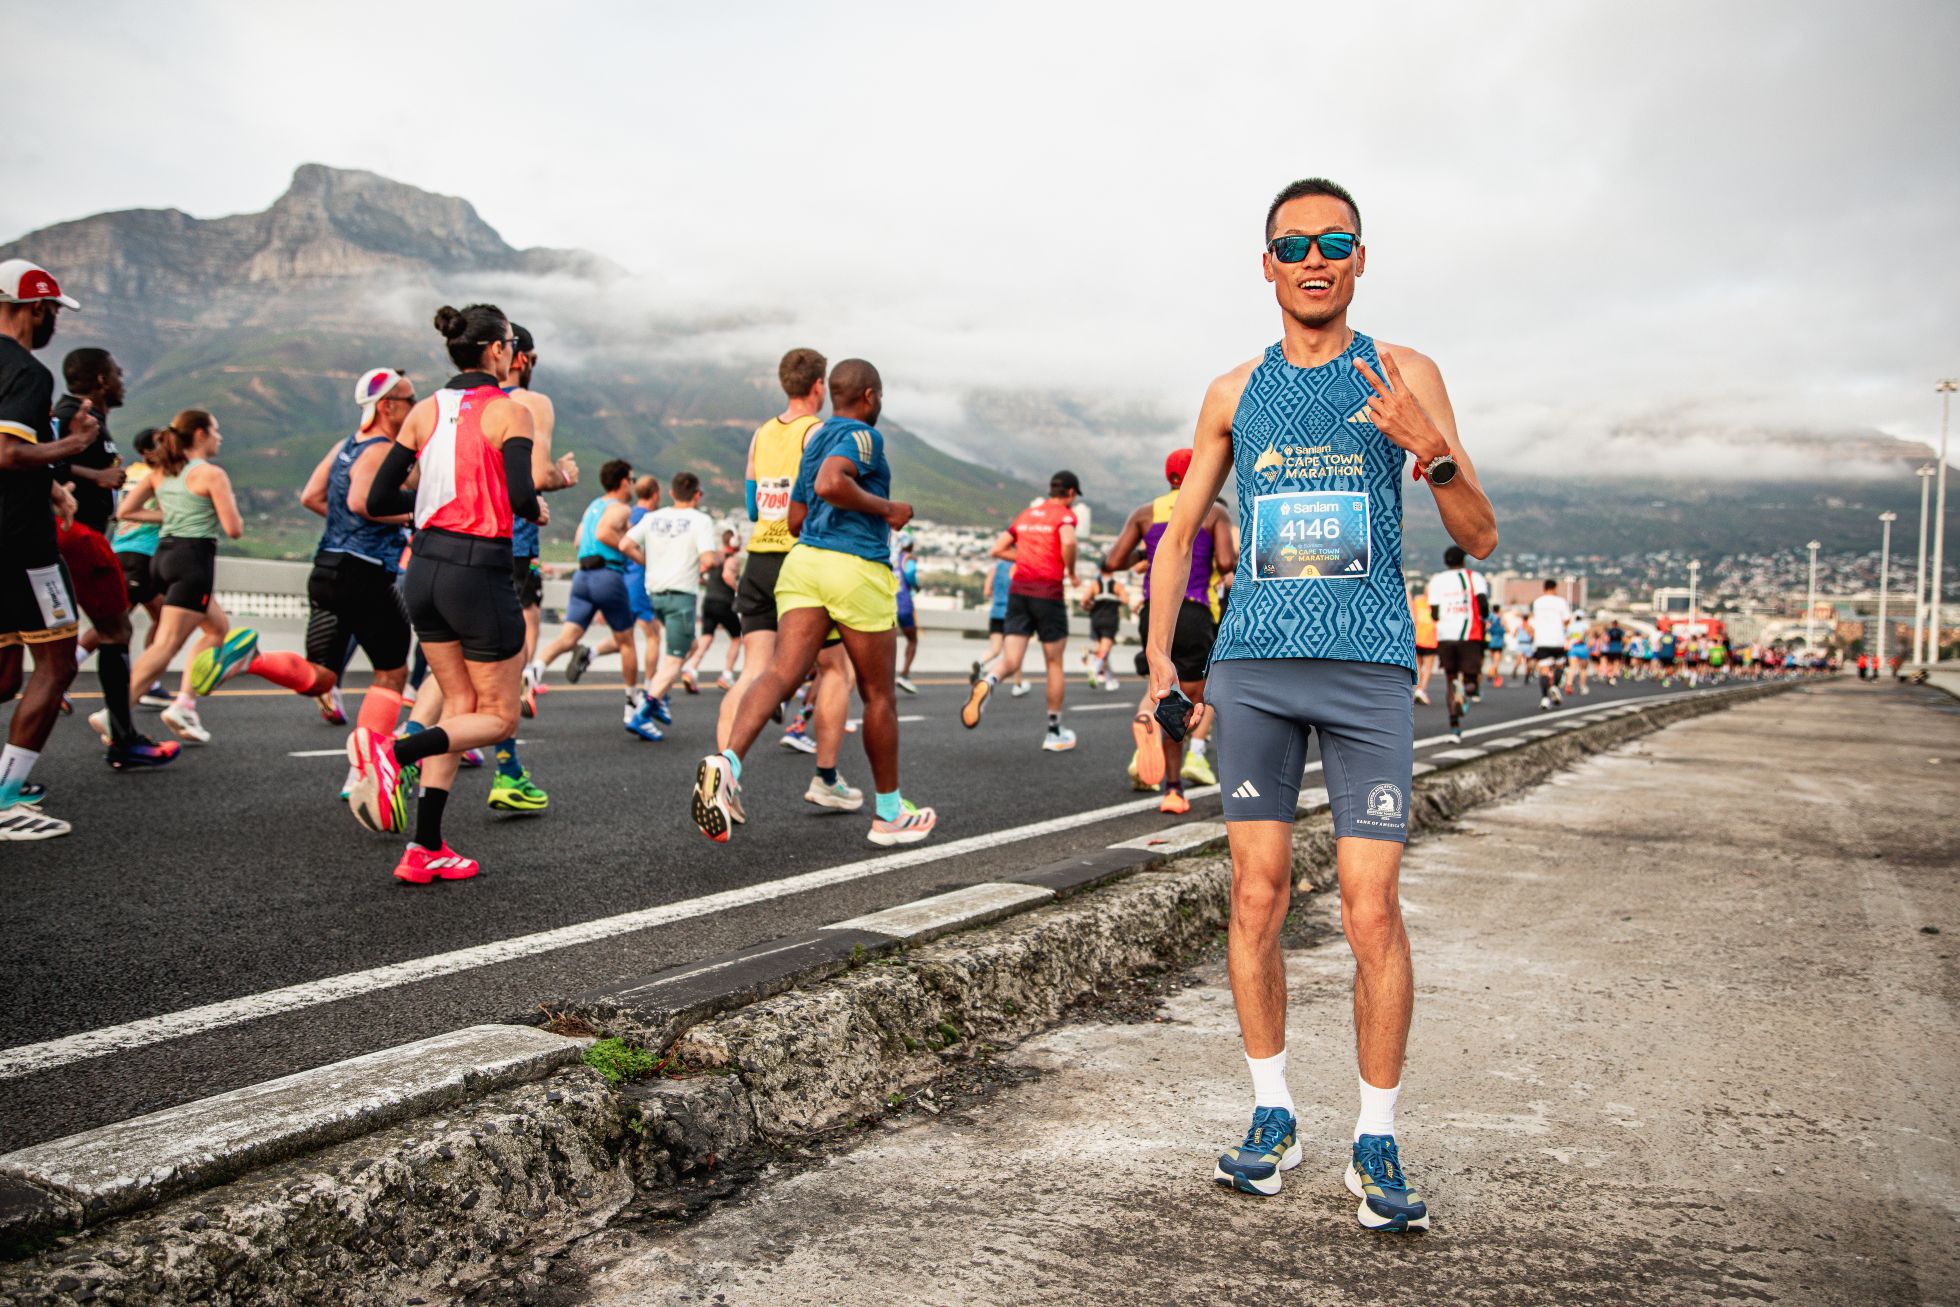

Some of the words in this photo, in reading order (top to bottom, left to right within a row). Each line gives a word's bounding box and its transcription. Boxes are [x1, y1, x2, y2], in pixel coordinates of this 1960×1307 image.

[1295, 445, 1331, 455] Sanlam
[1286, 456, 1320, 467] CAPE
[1324, 454, 1363, 465] TOWN
[1286, 465, 1363, 478] MARATHON
[1294, 501, 1339, 513] Sanlam
[1280, 518, 1340, 540] 4146
